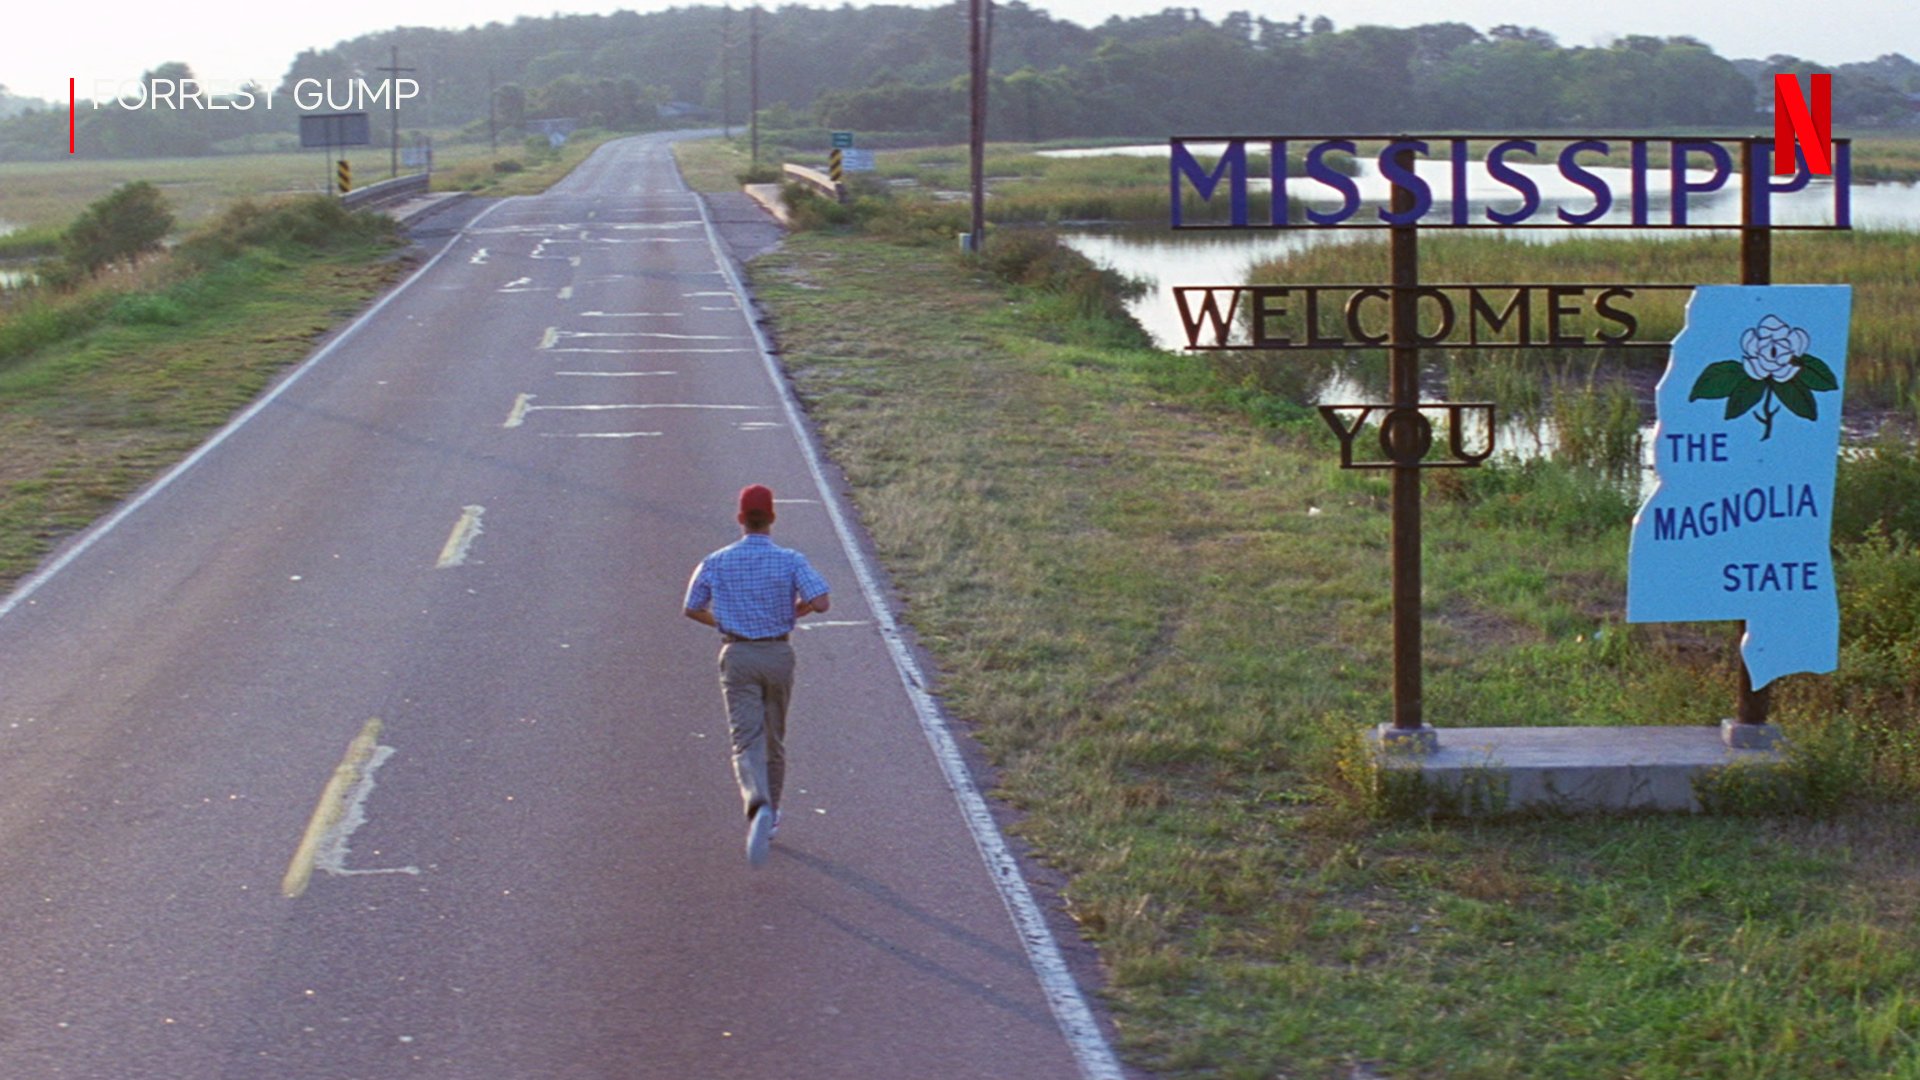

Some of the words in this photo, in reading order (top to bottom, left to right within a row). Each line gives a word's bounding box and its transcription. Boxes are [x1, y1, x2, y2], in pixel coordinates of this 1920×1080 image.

[1170, 138, 1851, 228] MISSISSIPPI
[1173, 286, 1639, 347] WELCOMES
[1318, 404, 1496, 468] YOU
[1666, 433, 1728, 463] THE
[1654, 484, 1819, 541] MAGNOLIA
[1723, 562, 1819, 592] STATE
